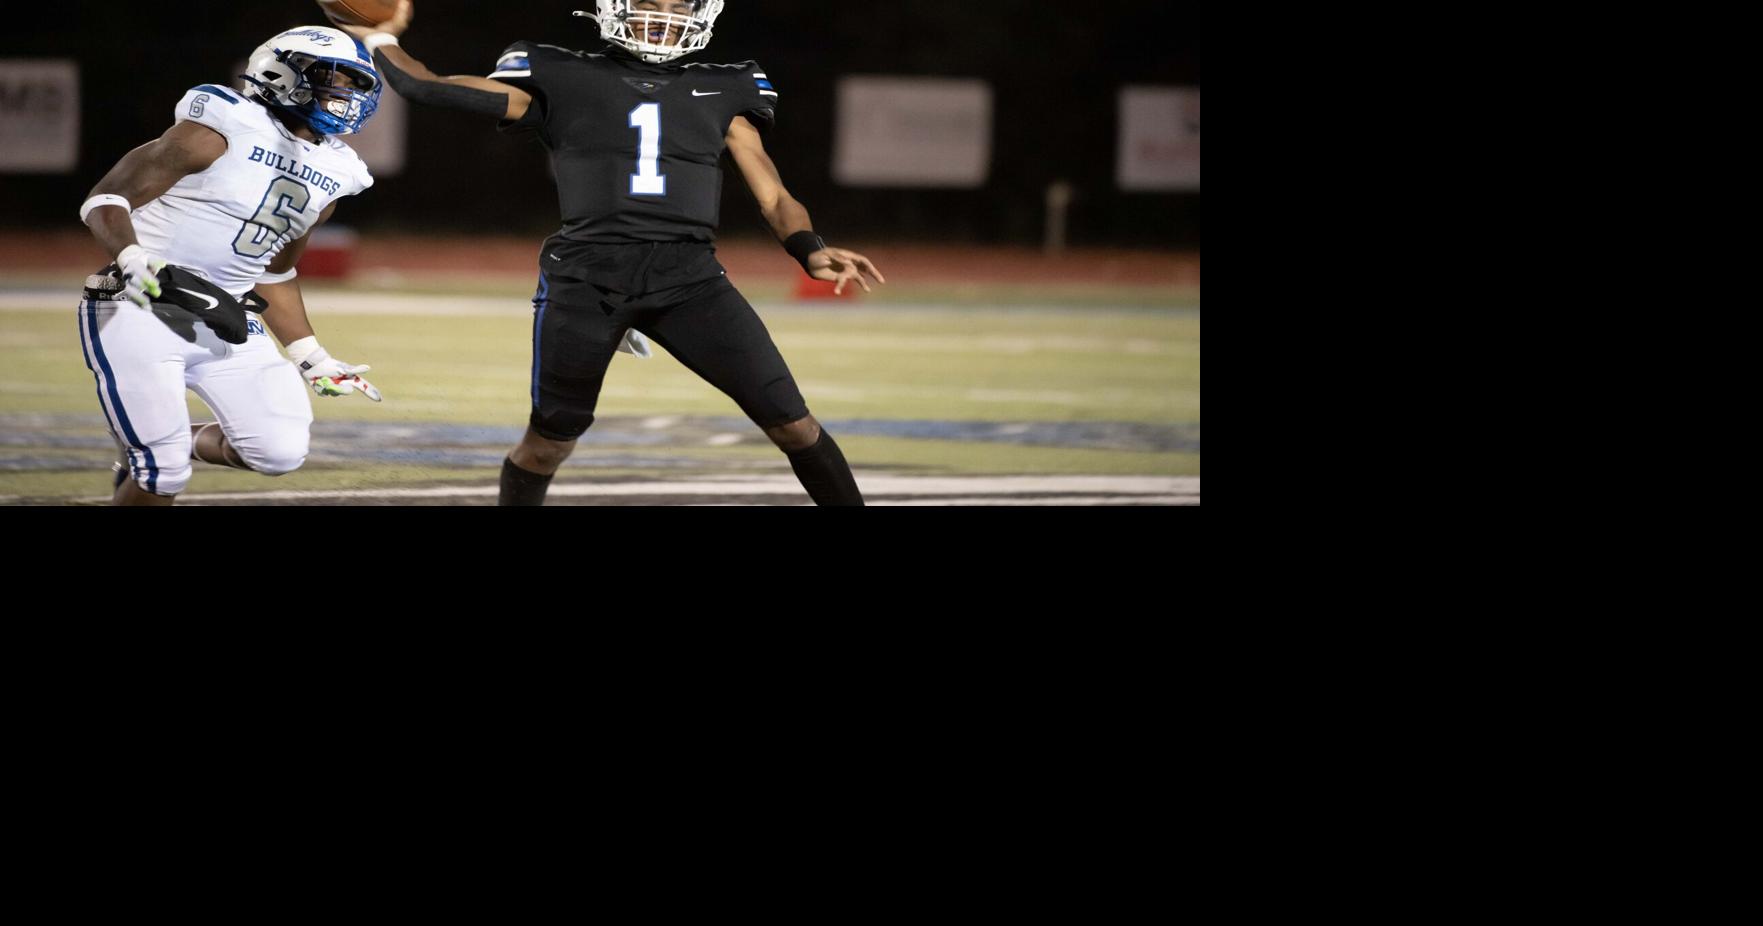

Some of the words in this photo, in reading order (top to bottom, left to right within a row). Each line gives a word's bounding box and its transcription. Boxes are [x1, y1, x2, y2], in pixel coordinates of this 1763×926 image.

[188, 94, 210, 119] 6
[248, 146, 341, 196] BULLDOGS
[628, 102, 666, 196] 1
[231, 175, 311, 259] 6
